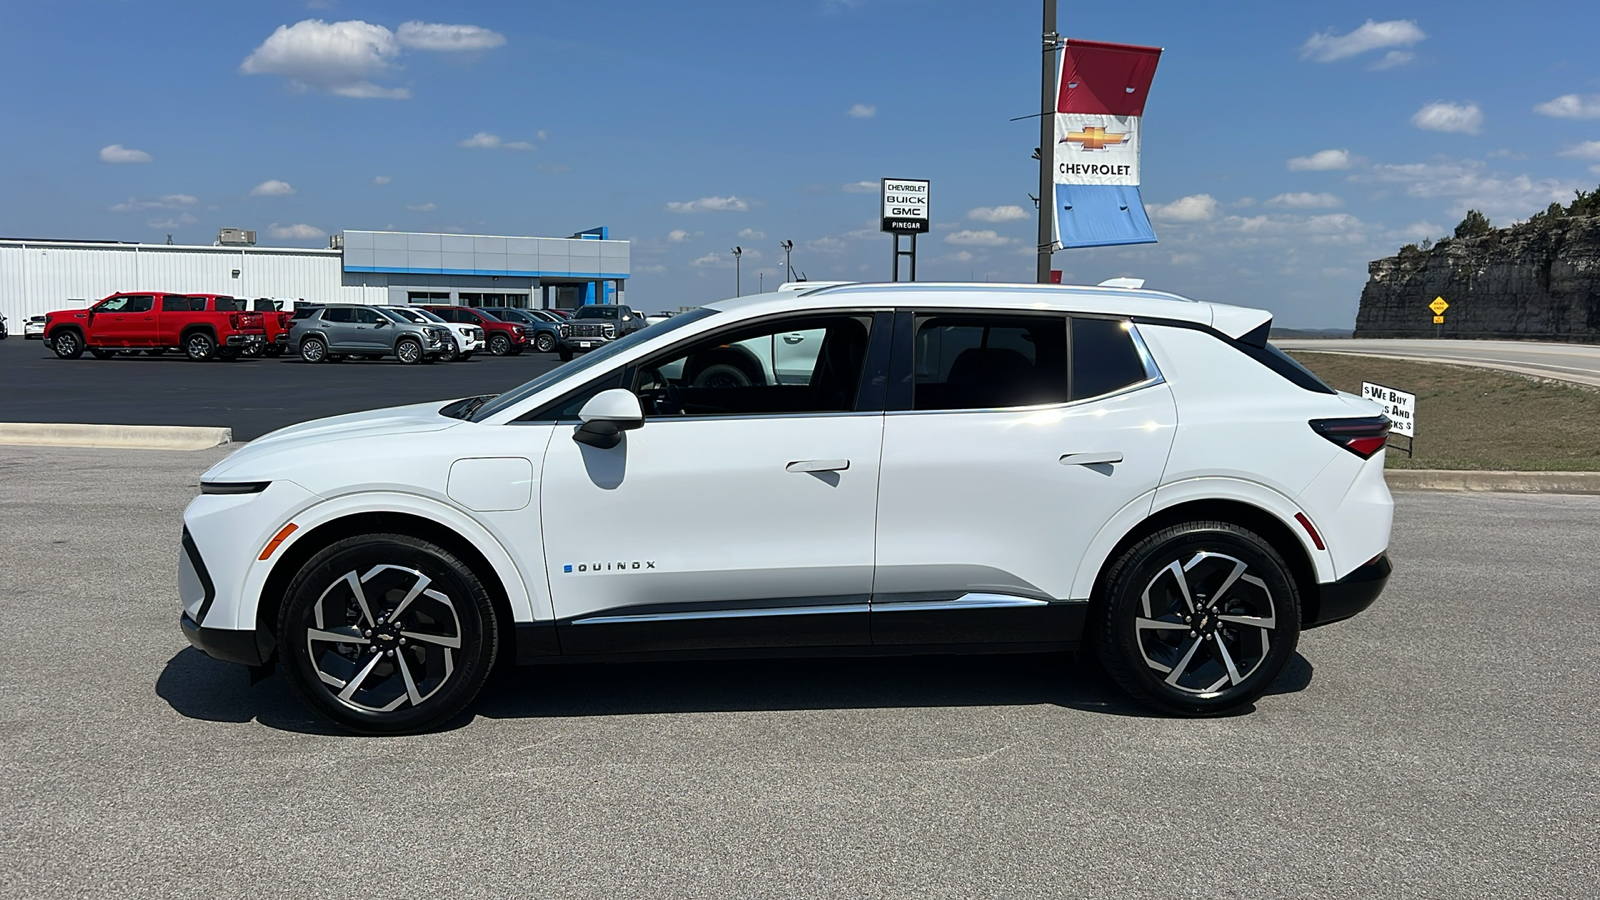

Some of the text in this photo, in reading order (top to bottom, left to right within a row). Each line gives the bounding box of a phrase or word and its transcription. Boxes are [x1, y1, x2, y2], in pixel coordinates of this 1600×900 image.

[1059, 163, 1131, 176] CHEVROLET
[887, 184, 926, 193] CHEVROLET
[886, 196, 926, 204] BUICK
[892, 207, 921, 215] GMC
[564, 561, 655, 573] EQUINOX
